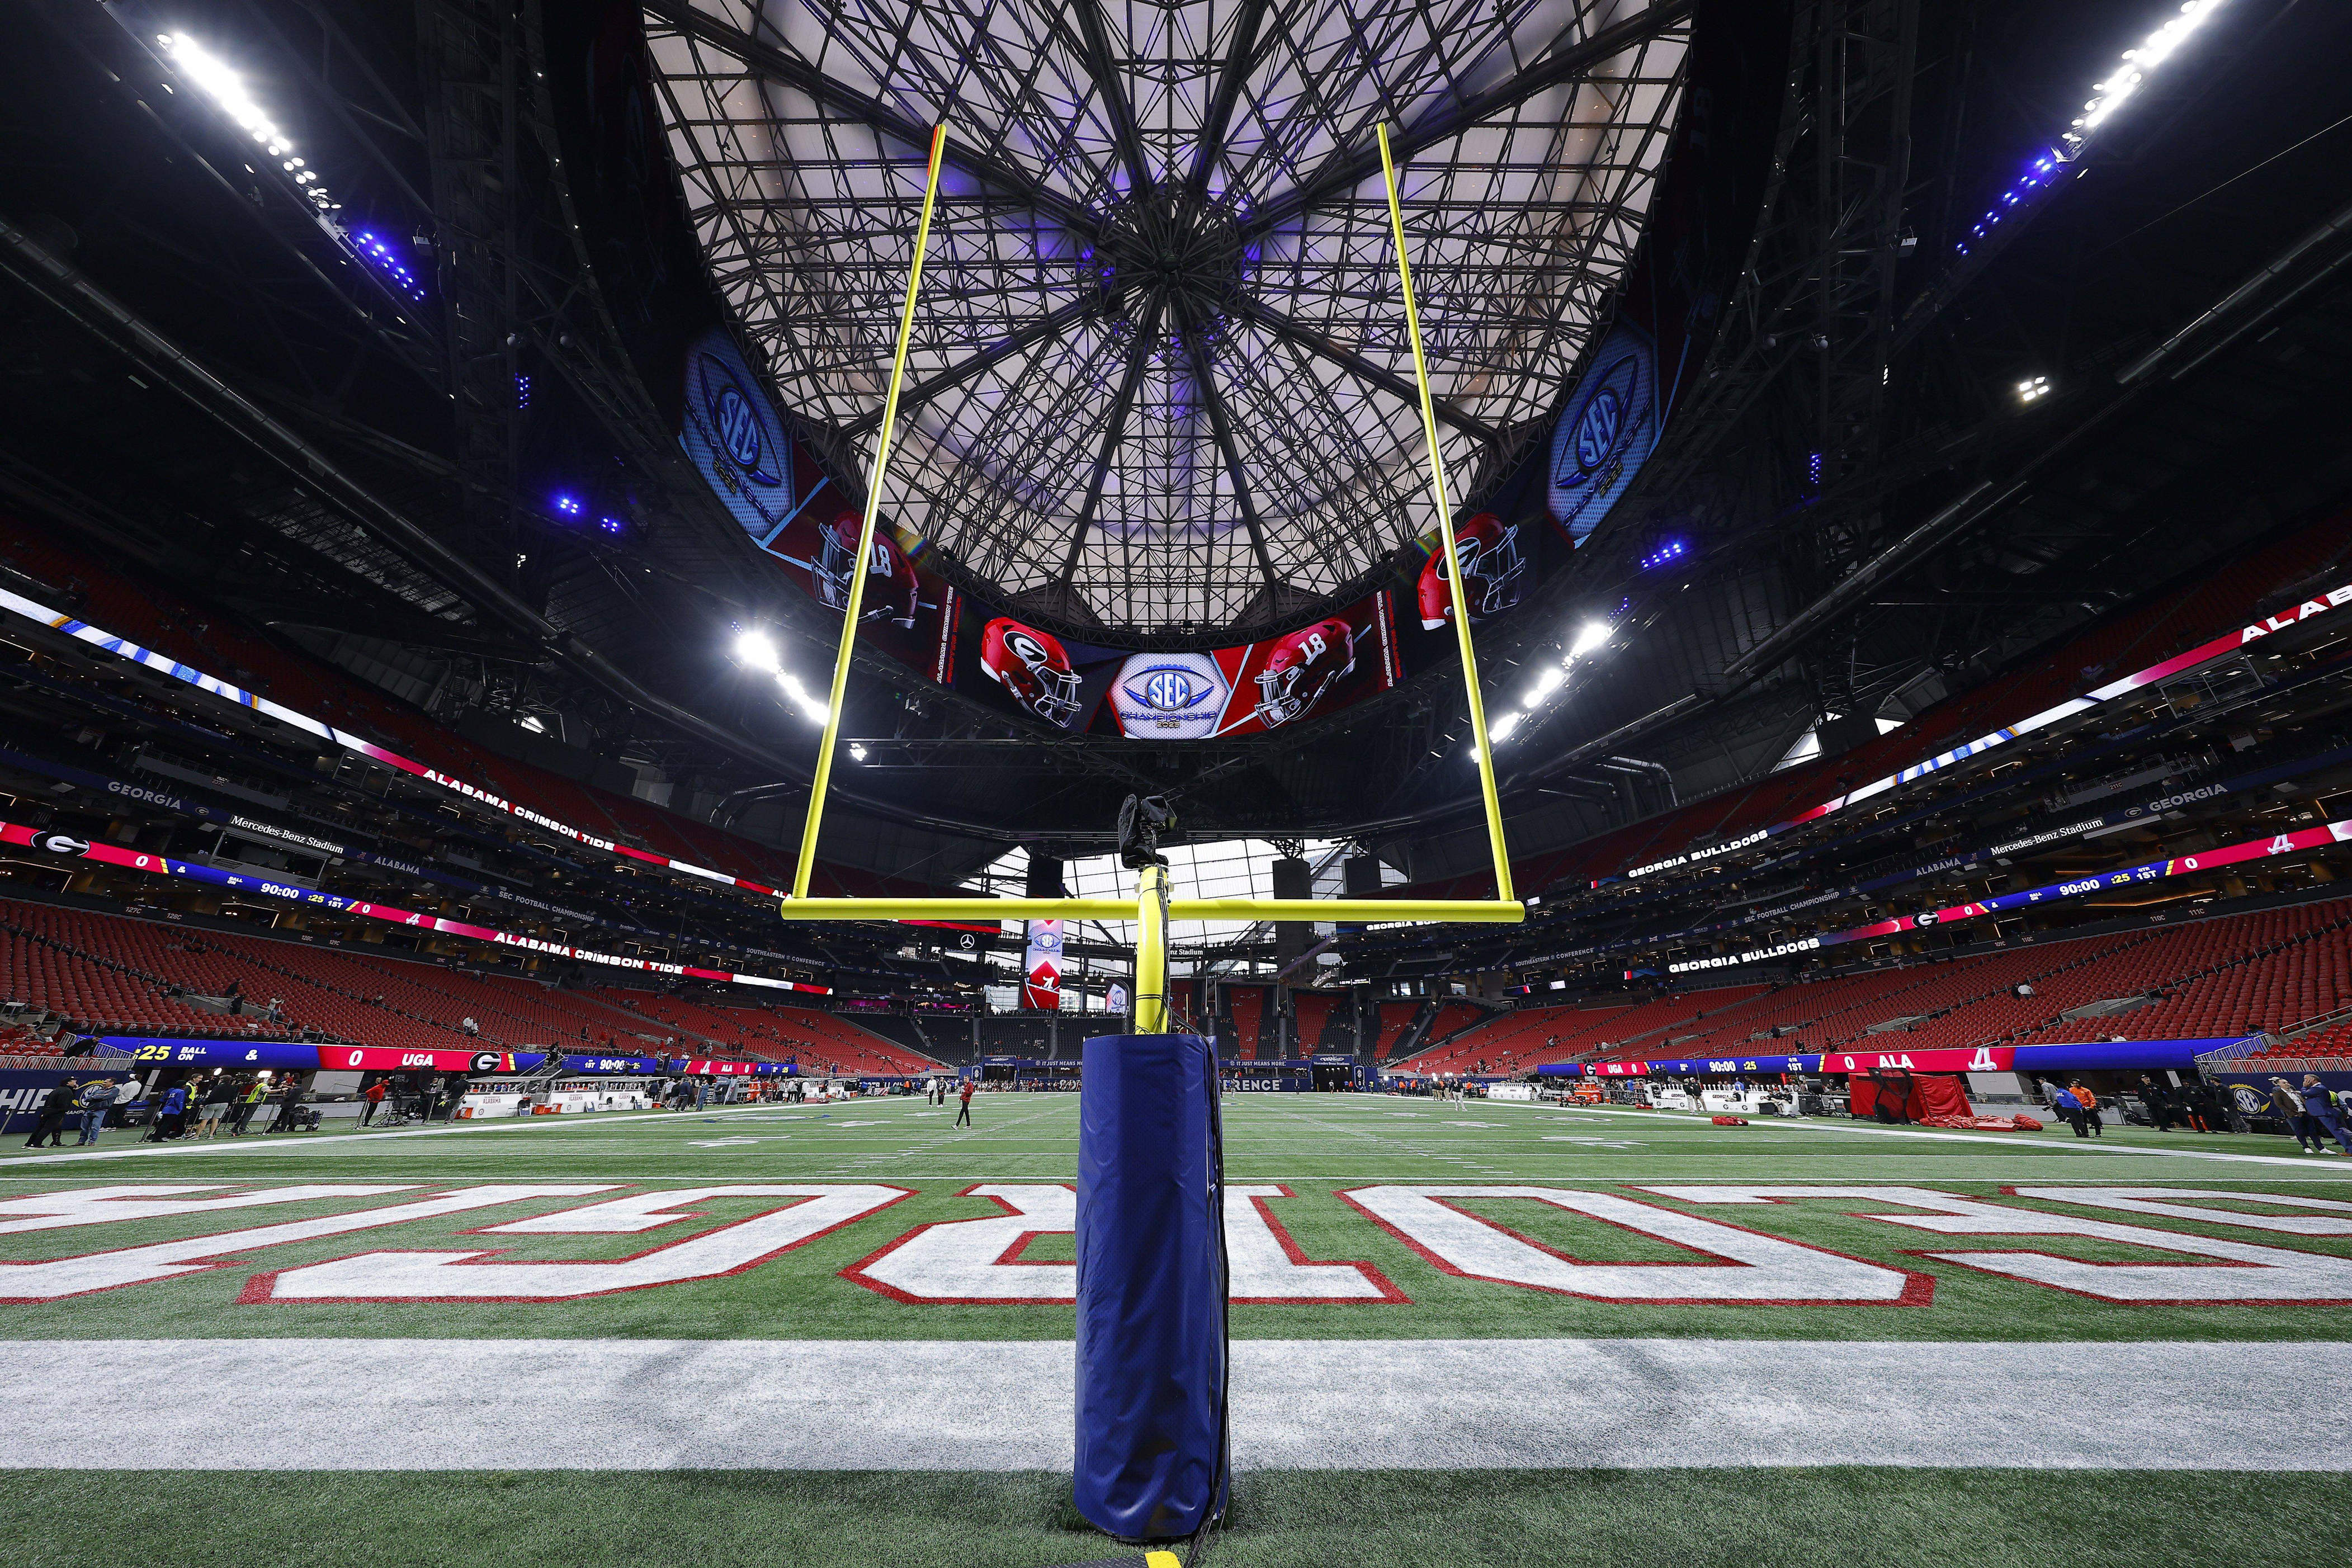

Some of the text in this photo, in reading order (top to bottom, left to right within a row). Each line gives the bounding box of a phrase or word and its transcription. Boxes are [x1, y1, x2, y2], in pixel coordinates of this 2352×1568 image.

[719, 391, 758, 461] SEC
[1579, 393, 1617, 466] SEC
[1298, 633, 1326, 664] 18
[1149, 673, 1190, 707] SEC
[1120, 711, 1217, 721] CHAMPIONSHIP
[107, 781, 182, 810] GEORGIA
[2148, 783, 2228, 812] GEORGIA
[423, 769, 615, 851] ALABAMA CRIMSON TIDE
[230, 815, 344, 854] Mercedes-Benz Stadium
[1990, 818, 2104, 856] Mercedes-Benz Stadium
[135, 856, 149, 867] 0
[1628, 829, 1769, 879] GEORGIA BULLDOGS
[2184, 857, 2198, 869] 0
[177, 865, 186, 873] &
[374, 856, 421, 876] ALABAMA
[1915, 857, 1962, 877] ALABAMA
[2136, 870, 2157, 881] 1ST
[260, 882, 325, 904] 90:00 :25
[2058, 873, 2131, 896] 90:00 :25
[328, 900, 343, 909] 1ST
[362, 904, 371, 914] 0
[498, 890, 594, 923] SEC FOOTBALL CHAMPIONSHIP
[1757, 906, 1789, 920] FOOTBALL
[1789, 891, 1840, 911] CHAMPIONSHIP
[1963, 905, 1973, 915] 0
[2189, 907, 2205, 917] 111C
[2150, 914, 2166, 923] 110C
[493, 932, 684, 975] ALABAMA CRIMSON TIDE
[746, 947, 825, 967] SOUTHEASTERN CONFERENCE
[1515, 947, 1594, 967] SOUTHEASTERN CONFERENCE
[1668, 937, 1820, 974] GEORGIA BULLDOGS
[135, 1045, 207, 1061] :25 BALL
[245, 1049, 258, 1061] &
[348, 1050, 363, 1066] 0
[402, 1053, 433, 1066] UGA
[1844, 1056, 1855, 1070] 0
[1878, 1054, 1915, 1069] ALA
[721, 1064, 733, 1073] ALA
[744, 1064, 750, 1073] 0
[1607, 1064, 1624, 1074] UGA
[1631, 1064, 1638, 1074] 0
[1709, 1060, 1757, 1073] 90:00 :25
[1787, 1062, 1802, 1071] 1ST
[2236, 1091, 2255, 1112] SEC
